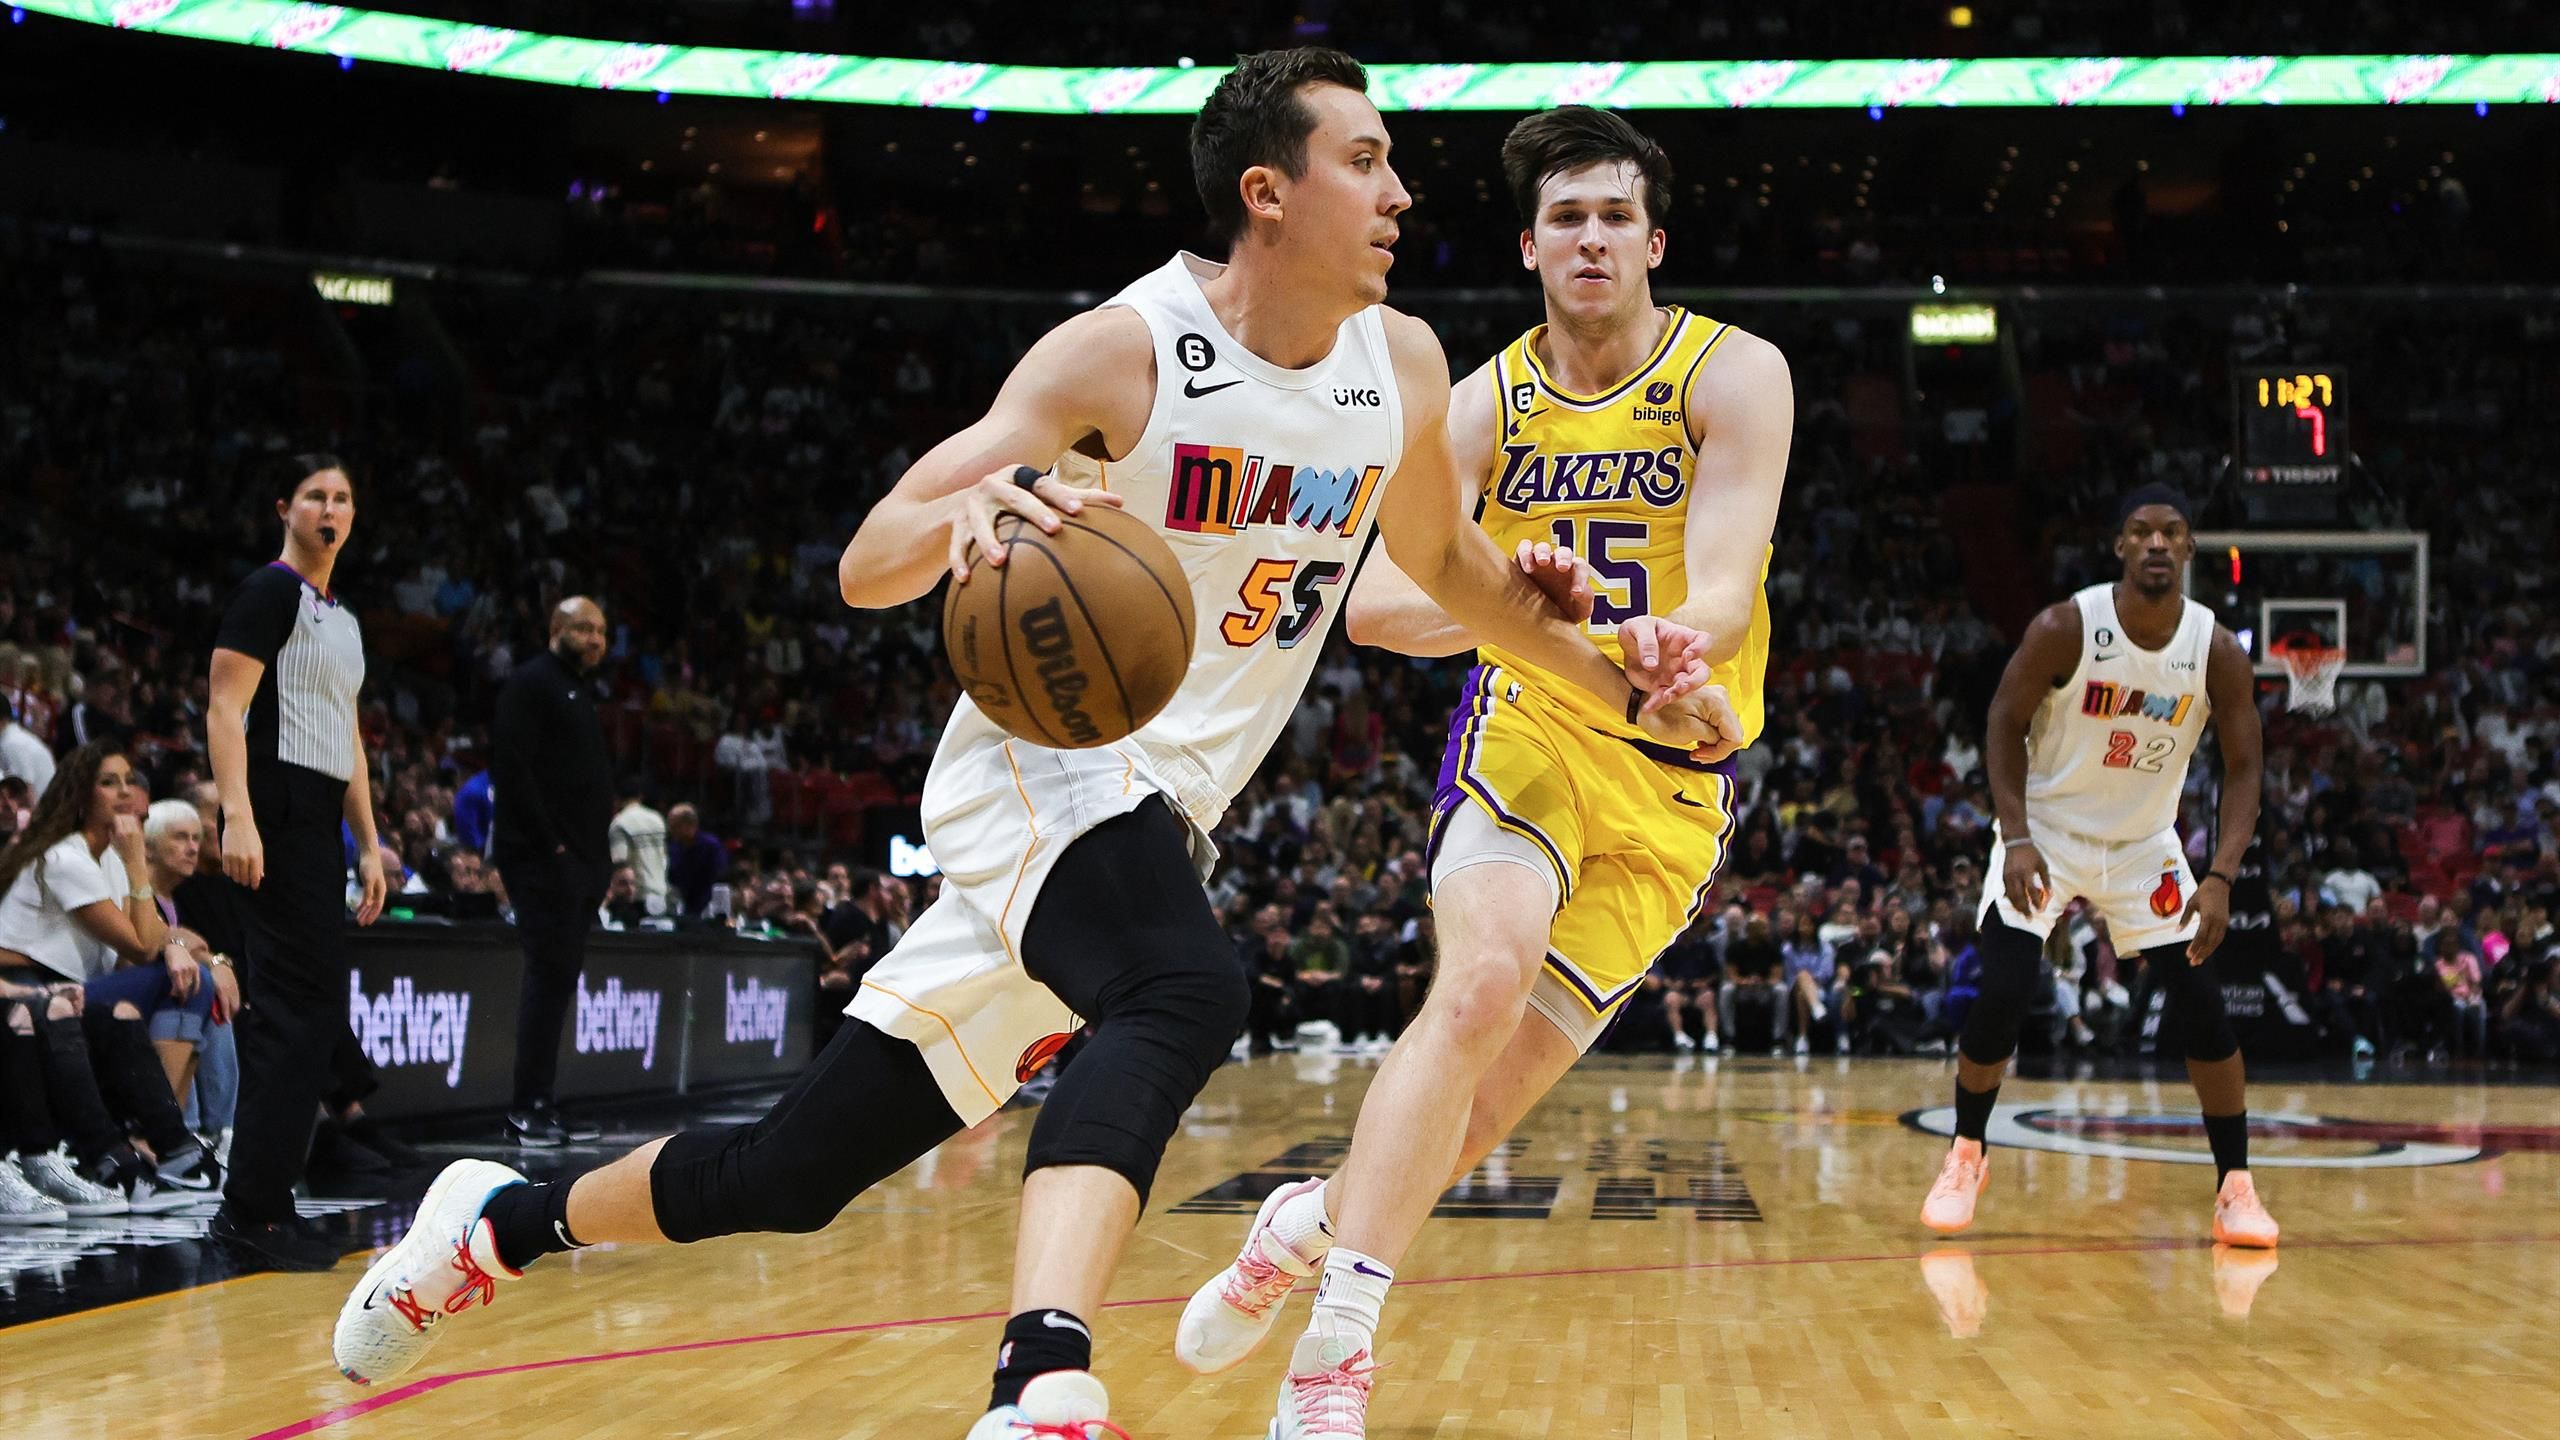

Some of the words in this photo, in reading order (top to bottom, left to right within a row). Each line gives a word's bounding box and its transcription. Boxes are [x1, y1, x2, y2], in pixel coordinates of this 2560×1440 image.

[1184, 339, 1206, 367] 6
[1516, 387, 1533, 411] 6
[1633, 407, 1681, 426] bibigo
[2296, 406, 2326, 456] 7
[1496, 443, 1686, 513] LAKERS
[1219, 558, 1345, 650] 55
[2103, 730, 2177, 773] 22
[349, 968, 471, 1088] betway
[576, 971, 662, 1071] betway
[725, 971, 788, 1058] betway
